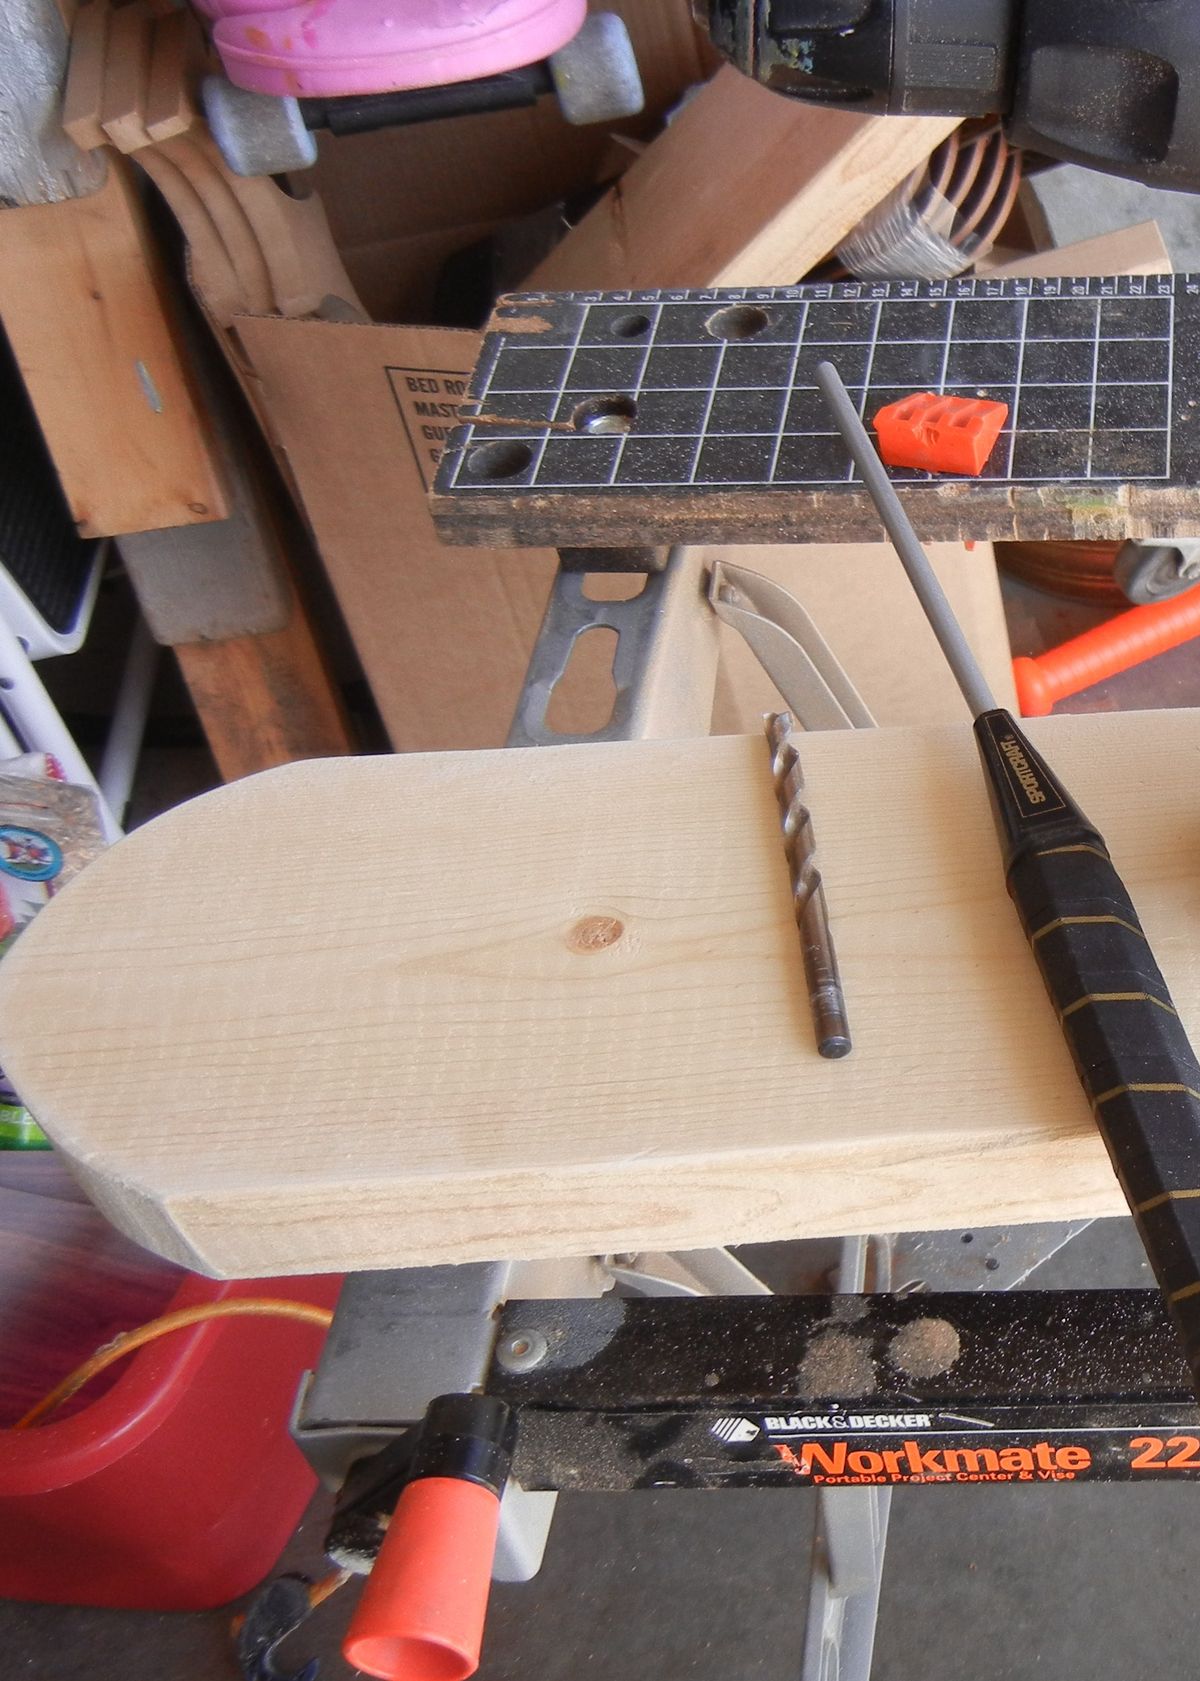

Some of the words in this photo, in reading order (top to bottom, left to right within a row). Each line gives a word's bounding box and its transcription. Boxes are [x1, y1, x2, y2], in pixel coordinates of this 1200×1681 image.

[786, 288, 800, 299] 10
[814, 286, 829, 298] 11
[843, 286, 857, 298] 12
[872, 285, 886, 298] 13
[901, 285, 914, 298] 14
[929, 284, 943, 297] 15
[958, 284, 972, 296] 16
[986, 284, 999, 296] 17
[1015, 284, 1028, 296] 18
[1044, 283, 1057, 296] 19
[1101, 283, 1114, 296] 21
[1129, 282, 1142, 296] 22
[1158, 282, 1171, 295] 23
[1186, 282, 1199, 295] 24
[404, 376, 439, 393] BED
[1000, 740, 1046, 804] SPORTCRAFT
[764, 1412, 932, 1431] BLACK&DECKER
[774, 1439, 1092, 1476] Workmate
[814, 1472, 888, 1484] Portable
[891, 1472, 954, 1485] Project
[956, 1470, 1016, 1482] Center
[1037, 1468, 1076, 1481] Vise
